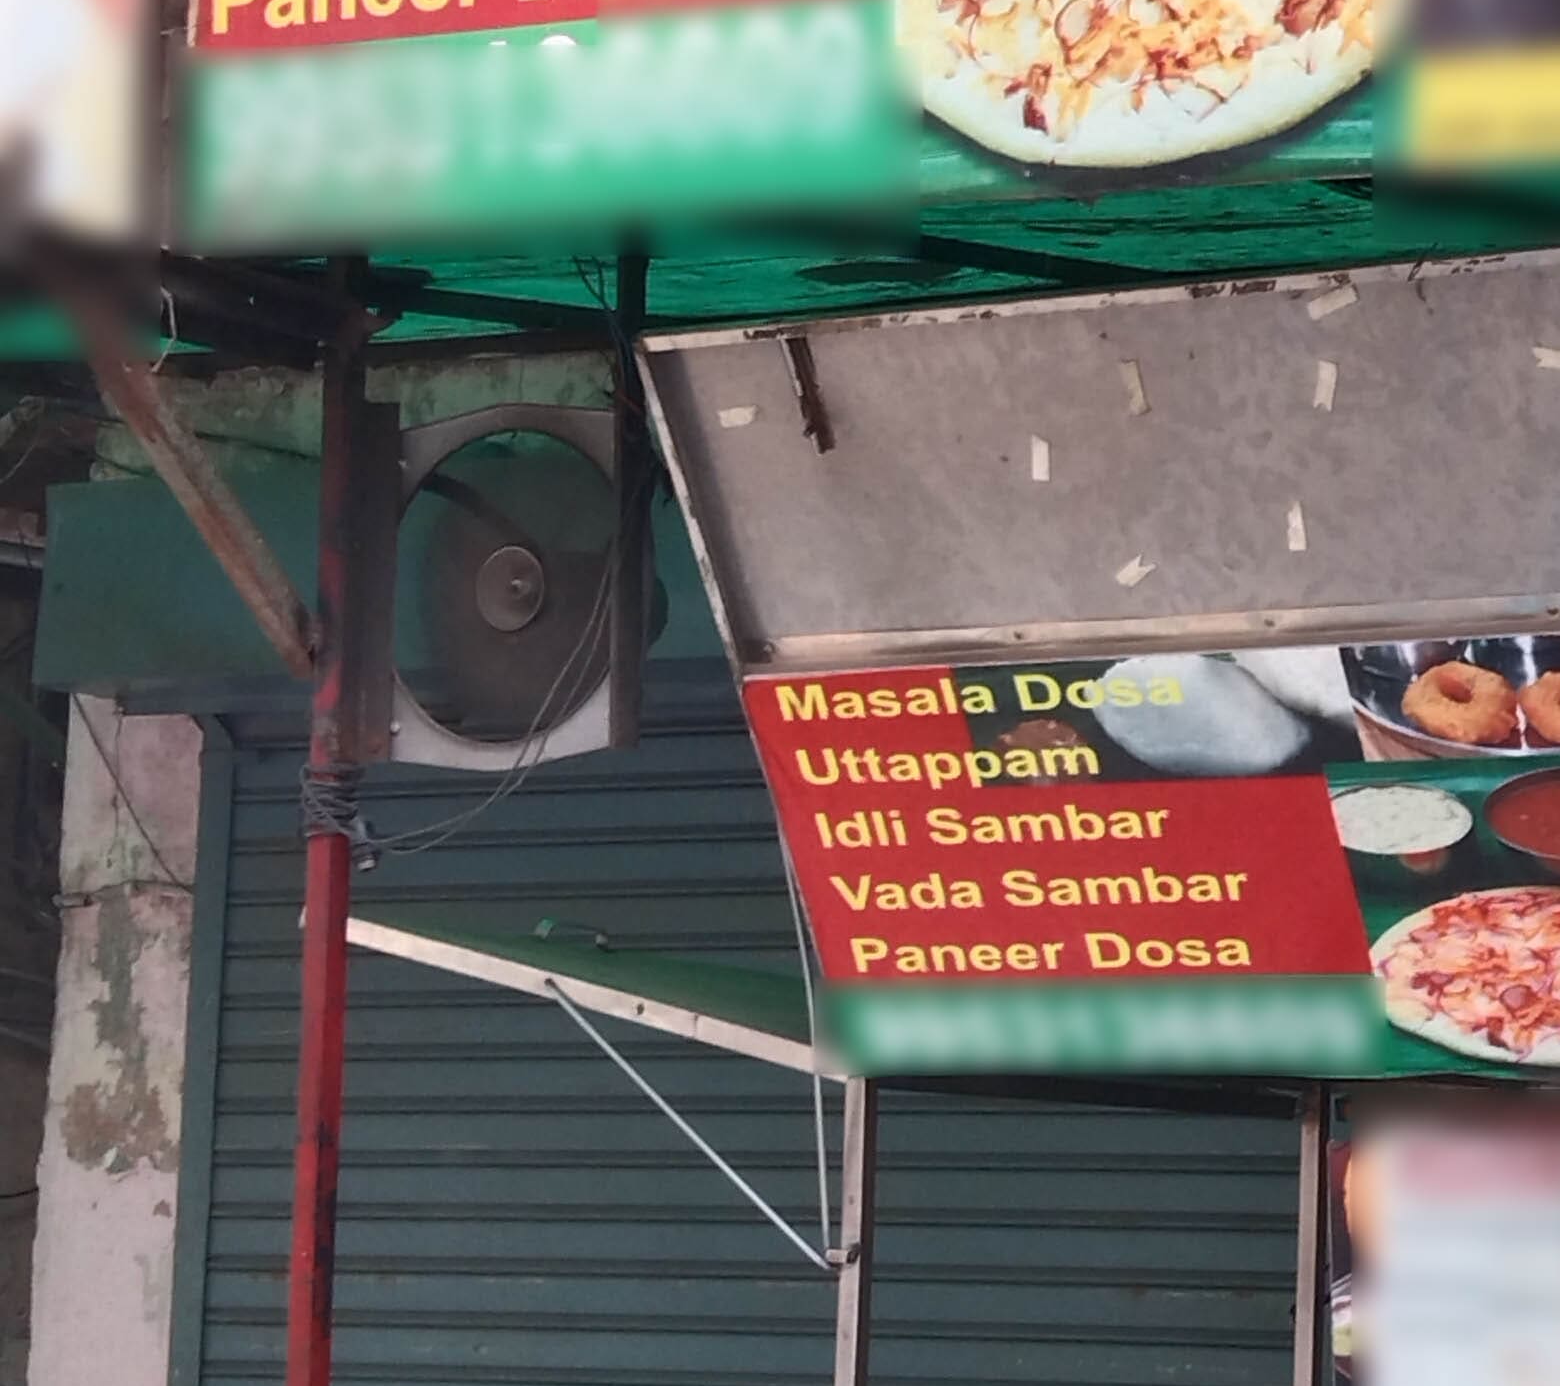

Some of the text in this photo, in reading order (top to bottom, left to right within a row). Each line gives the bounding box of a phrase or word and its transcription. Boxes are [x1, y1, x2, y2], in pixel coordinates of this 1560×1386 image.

[775, 671, 1184, 721] Masala Dosa
[795, 744, 1100, 789] Uttappam
[815, 804, 1170, 849] Idli Sambar
[830, 867, 1248, 911] Vada Sambar
[850, 932, 1250, 974] Paneer Dosa
